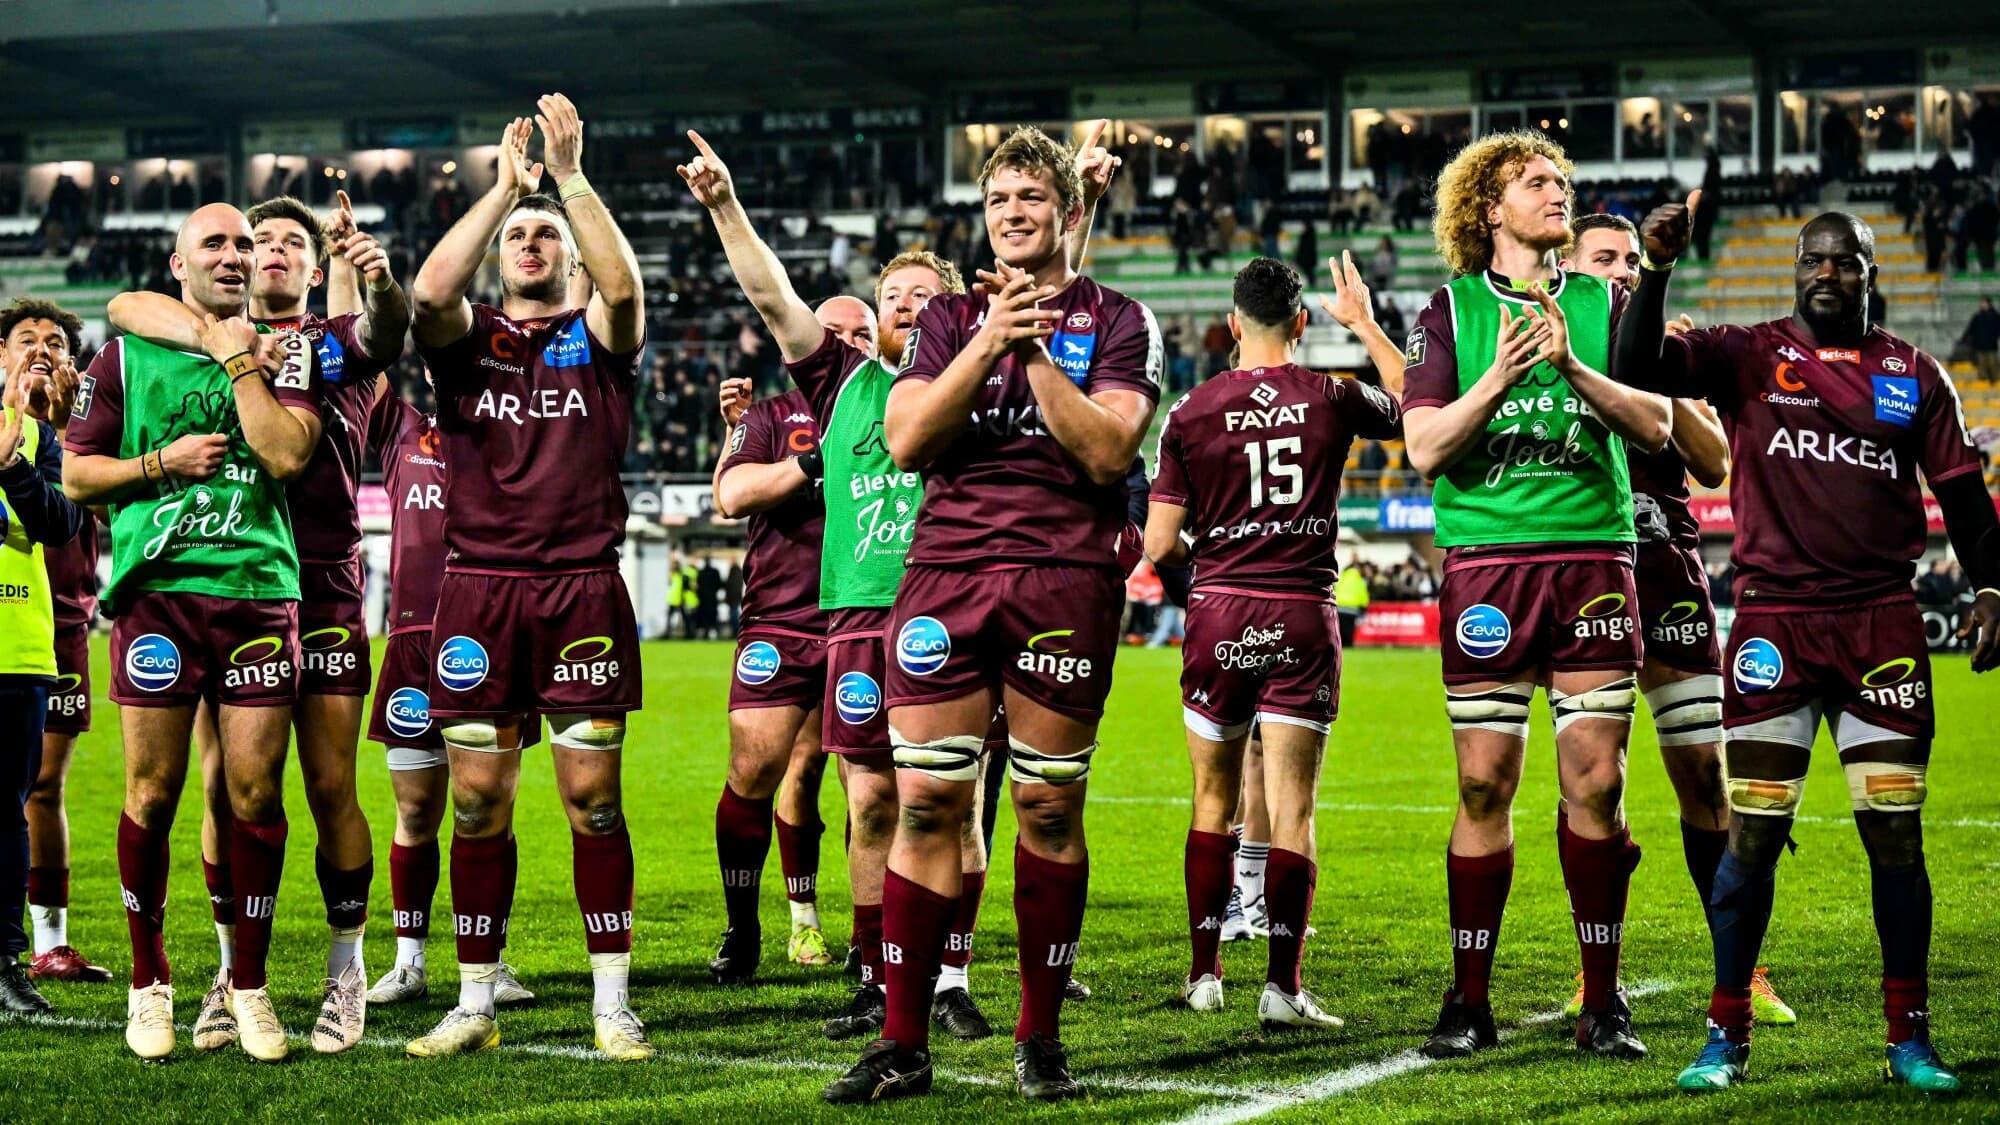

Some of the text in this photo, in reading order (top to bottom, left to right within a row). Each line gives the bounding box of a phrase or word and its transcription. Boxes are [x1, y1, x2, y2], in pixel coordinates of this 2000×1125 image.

[321, 355, 344, 368] MAN
[480, 356, 526, 376] discount
[1819, 350, 1857, 361] Betclic
[1759, 392, 1821, 408] Cdiscount
[1878, 396, 1918, 415] HUMAN
[1225, 402, 1310, 432] FAYAT
[1485, 421, 1593, 488] Jock
[1766, 427, 1898, 480] ARKEA
[224, 463, 257, 485] au
[1243, 436, 1304, 509] 15
[143, 489, 253, 560] Jock
[854, 497, 916, 563] Joc
[1209, 514, 1328, 539] edenauto
[1574, 614, 1634, 641] ange
[1651, 619, 1709, 645] ange
[225, 660, 291, 688] ange
[553, 660, 620, 687] ange
[1016, 651, 1092, 684] ange
[48, 694, 86, 716] nge
[585, 910, 633, 934] UBB
[1579, 921, 1623, 944] UBB
[944, 933, 974, 951] BB
